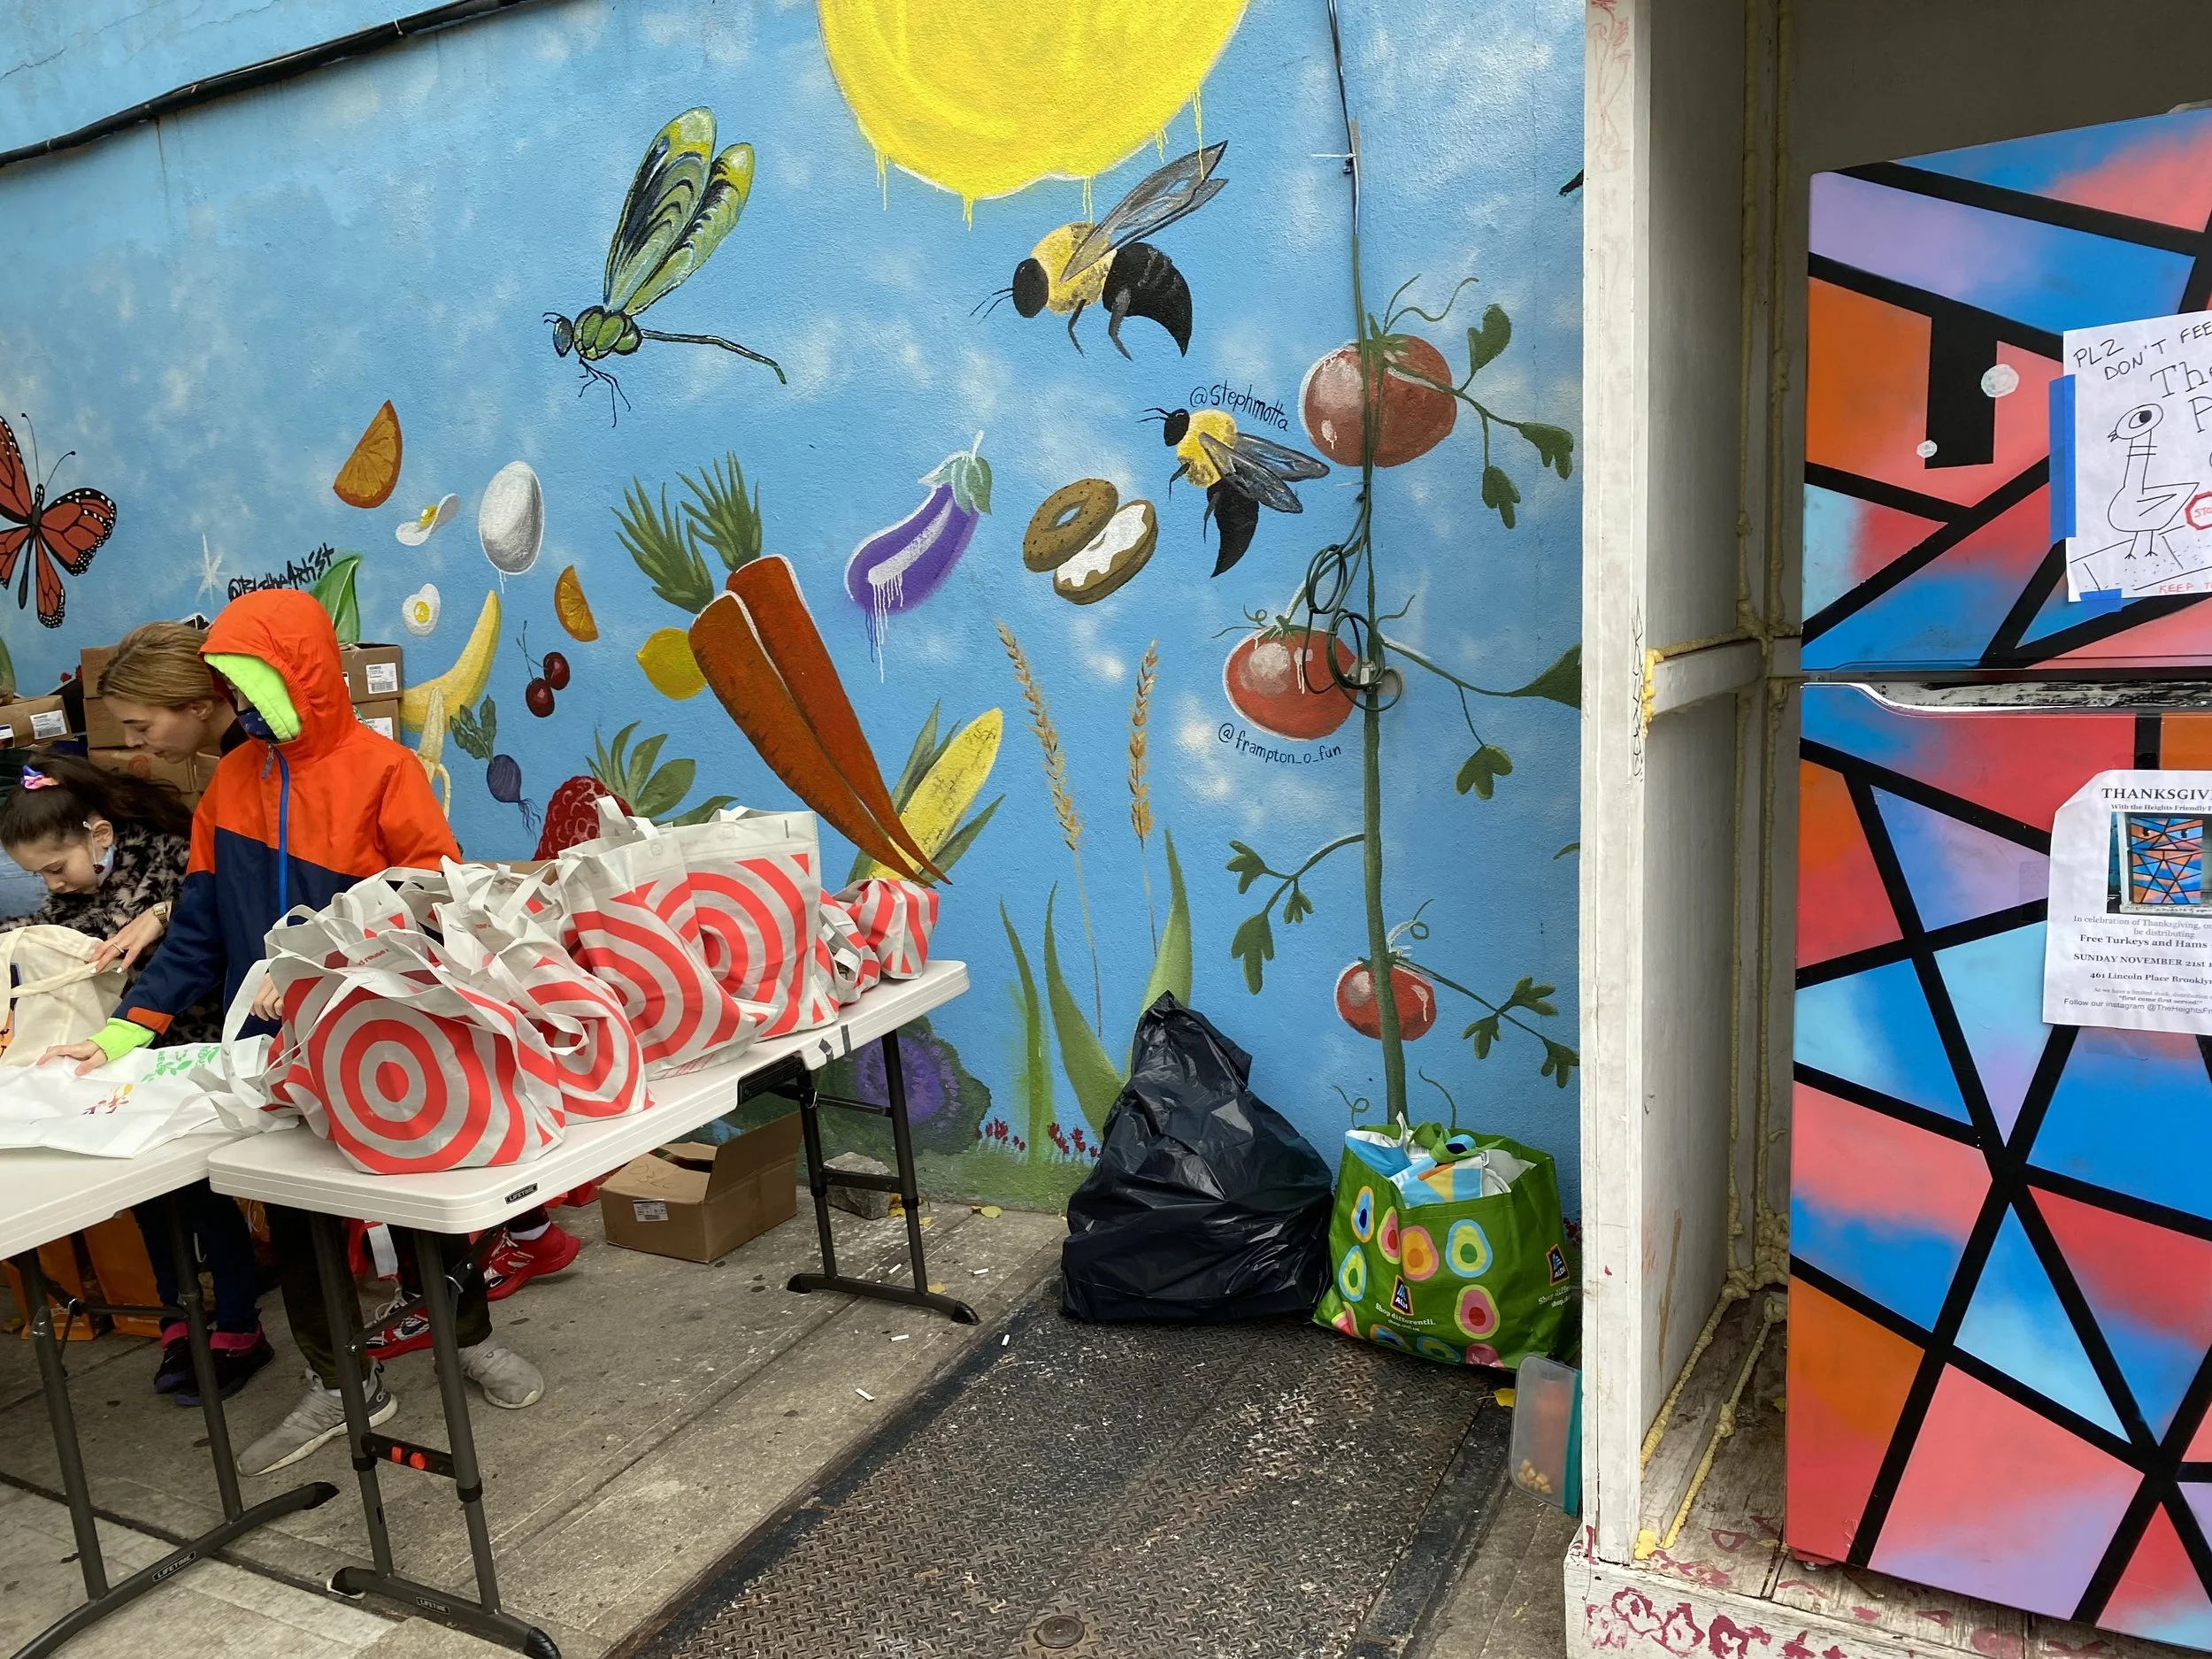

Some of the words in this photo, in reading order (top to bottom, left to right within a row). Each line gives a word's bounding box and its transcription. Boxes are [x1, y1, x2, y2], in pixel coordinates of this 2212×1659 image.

[2104, 338, 2167, 380] DON'T
[2159, 582, 2194, 594] KEEP
[2101, 787, 2212, 801] THANKSGIV
[2084, 916, 2130, 926] celebration
[2142, 918, 2201, 931] Thanksgiving,
[2146, 928, 2195, 940] distributing
[2080, 934, 2103, 943] Free
[2106, 935, 2149, 948] Turkeys
[2176, 940, 2208, 949] Hams
[2073, 953, 2118, 963] SUNDAY
[2120, 956, 2183, 966] NOVEMBER
[2108, 972, 2143, 981] Lincoln
[2063, 997, 2089, 1007] Follow
[1554, 1265, 1566, 1279] ALDI
[1375, 1302, 1391, 1317] Shop
